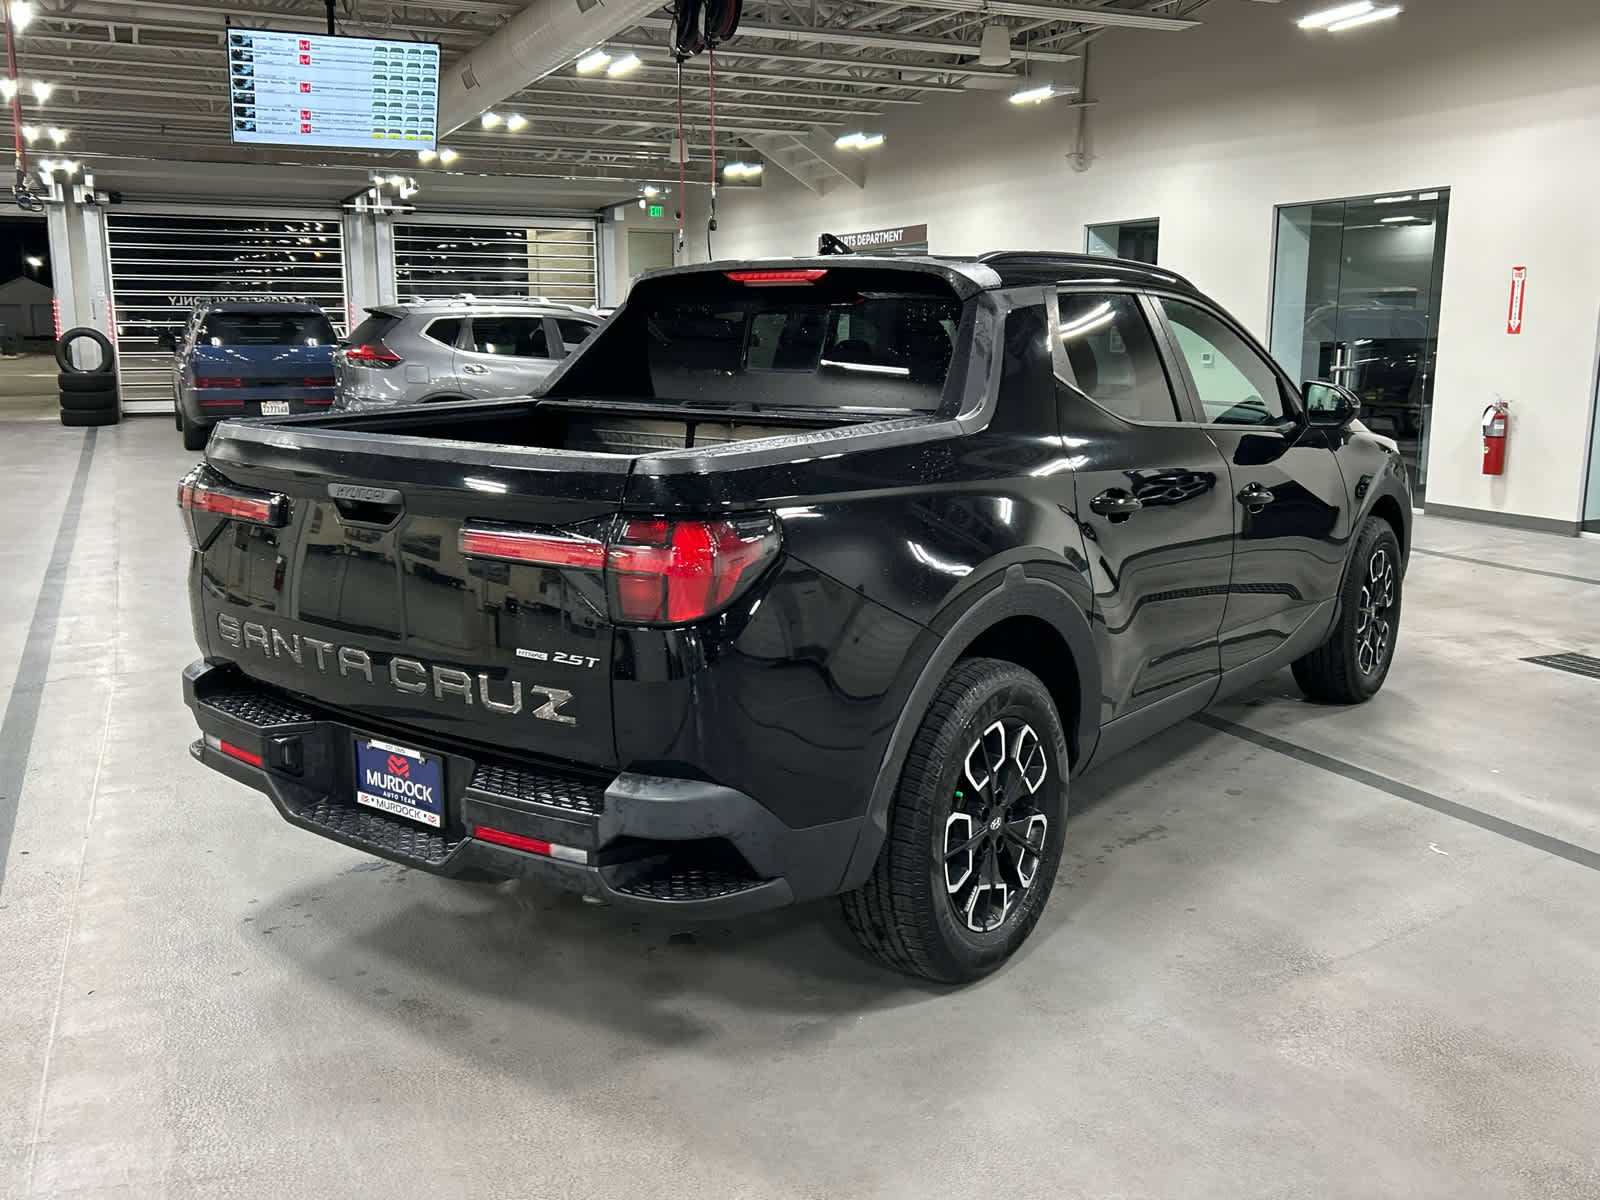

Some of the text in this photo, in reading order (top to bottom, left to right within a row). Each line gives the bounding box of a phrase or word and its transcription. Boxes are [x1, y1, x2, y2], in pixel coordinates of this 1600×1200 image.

[650, 206, 662, 217] EXIT
[837, 230, 903, 246] ARTS DEPARTMENT
[218, 612, 576, 726] SANTA CRUZ
[366, 769, 433, 803] MURDOCK
[383, 791, 416, 805] AUTO TEAM
[376, 799, 422, 819] MURDOCK
